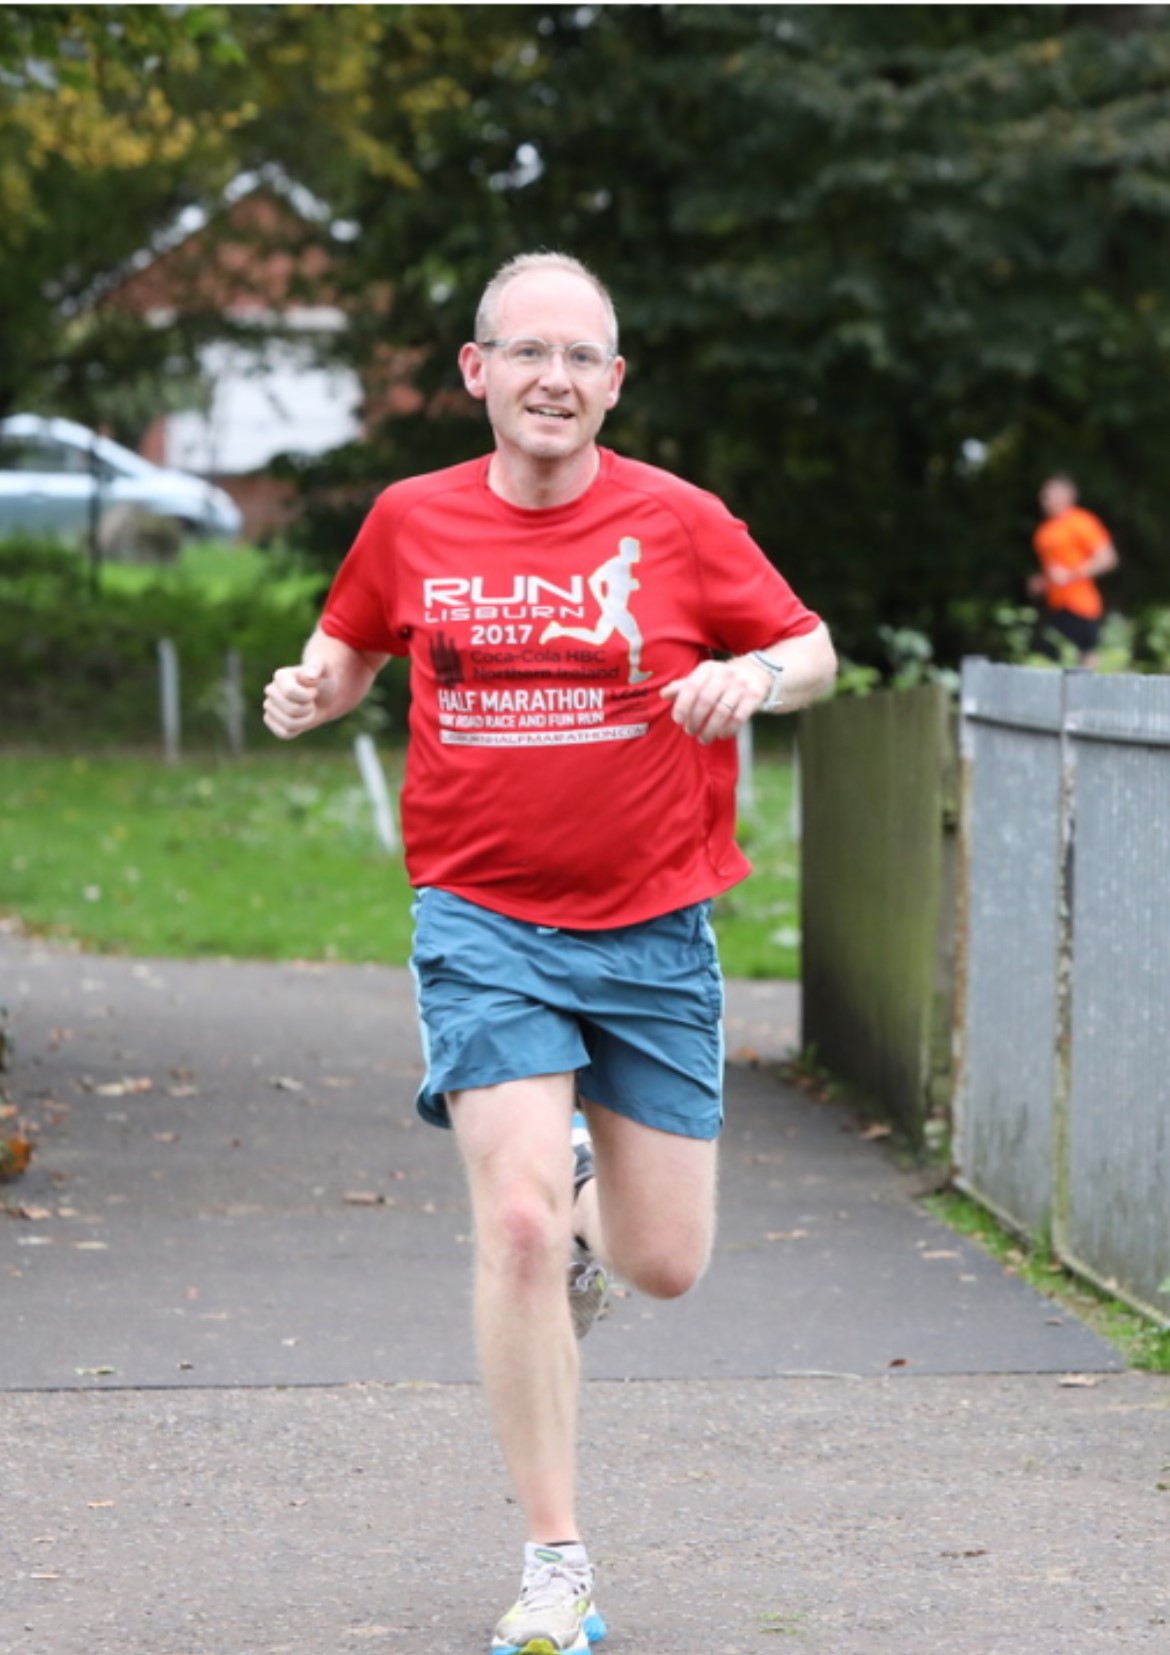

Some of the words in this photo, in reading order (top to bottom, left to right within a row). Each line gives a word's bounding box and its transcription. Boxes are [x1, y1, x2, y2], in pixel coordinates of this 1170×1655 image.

[424, 575, 583, 607] RUN
[424, 606, 584, 623] LISBURN
[470, 625, 533, 645] 2017
[470, 650, 561, 664] Coca-Cola
[566, 649, 605, 662] HBC
[438, 689, 477, 712] HALF
[481, 687, 604, 712] MARATHON
[485, 715, 516, 728] RACE
[518, 714, 547, 728] AND
[548, 713, 574, 727] FUN
[578, 711, 605, 725] RUN
